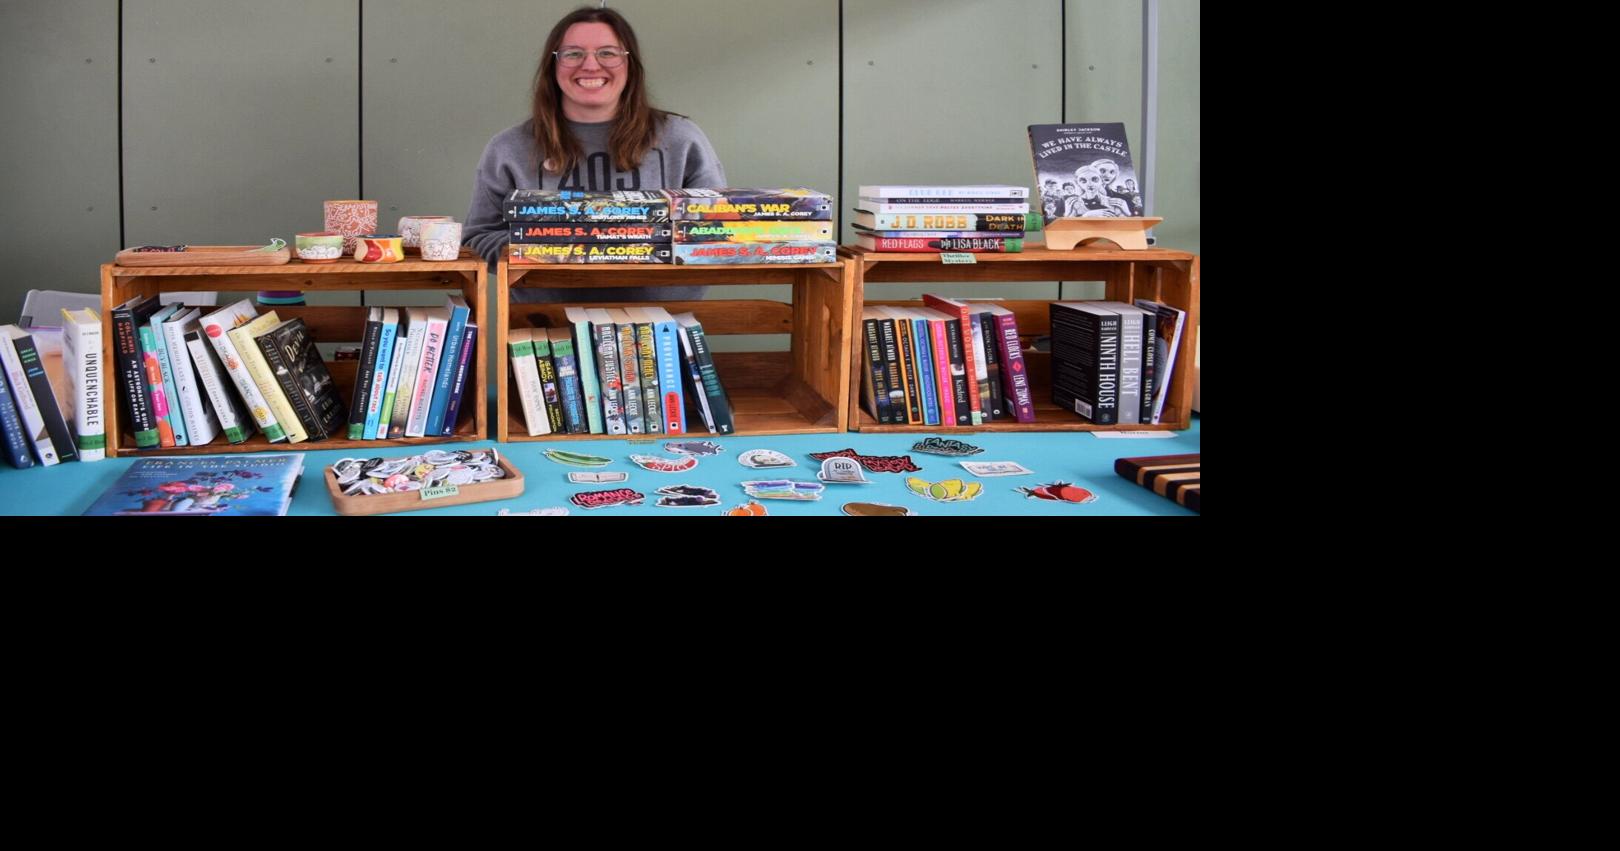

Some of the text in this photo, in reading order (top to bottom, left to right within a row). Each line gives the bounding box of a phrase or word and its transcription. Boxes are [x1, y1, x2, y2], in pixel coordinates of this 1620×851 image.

[1039, 147, 1062, 158] LIVED
[1094, 144, 1127, 157] CASTLE
[1085, 137, 1123, 148] ALWAYS
[519, 207, 650, 215] JAMES S. A. COREY
[687, 204, 790, 213] CALIBAN'S WAR
[525, 227, 654, 236] JAMES S. A. COREY
[890, 216, 968, 229] J. D. ROBB
[524, 247, 654, 255] JAMES S. A. COREY
[691, 247, 816, 257] JAMES S. A. COREY
[882, 239, 923, 248] RED FLAGS
[953, 239, 1000, 249] LISA BLACK
[386, 329, 392, 337] So
[868, 322, 880, 361] MARGARET ATWOOD
[884, 322, 896, 361] MARGARET ATWOOD
[450, 334, 459, 354] Urban
[1005, 328, 1021, 360] RED CLOCKS
[442, 354, 455, 389] Homelands
[538, 359, 548, 383] ASIMOV
[544, 361, 553, 380] ISAAC
[605, 360, 616, 383] JUSTICE
[663, 336, 675, 389] PROVENANCE
[1099, 336, 1117, 409] NINTH HOUSE
[1123, 335, 1140, 396] HELL BENT
[127, 370, 132, 379] TO
[700, 363, 721, 399] LAGOON
[85, 353, 99, 426] UNQUENCHABLE
[131, 360, 149, 431] AN ASTRONAUT'S GUIDE
[131, 394, 137, 402] ON
[374, 384, 382, 400] about
[956, 379, 966, 404] Kindred
[1014, 374, 1030, 406] LENI ZUMAS
[609, 389, 619, 416] ANN LECKIE
[628, 389, 638, 416] ANN LECKIE
[647, 388, 657, 415] ANN LECKIE
[133, 403, 141, 423] EARTH
[835, 462, 852, 470] RIP
[424, 489, 444, 497] Pins
